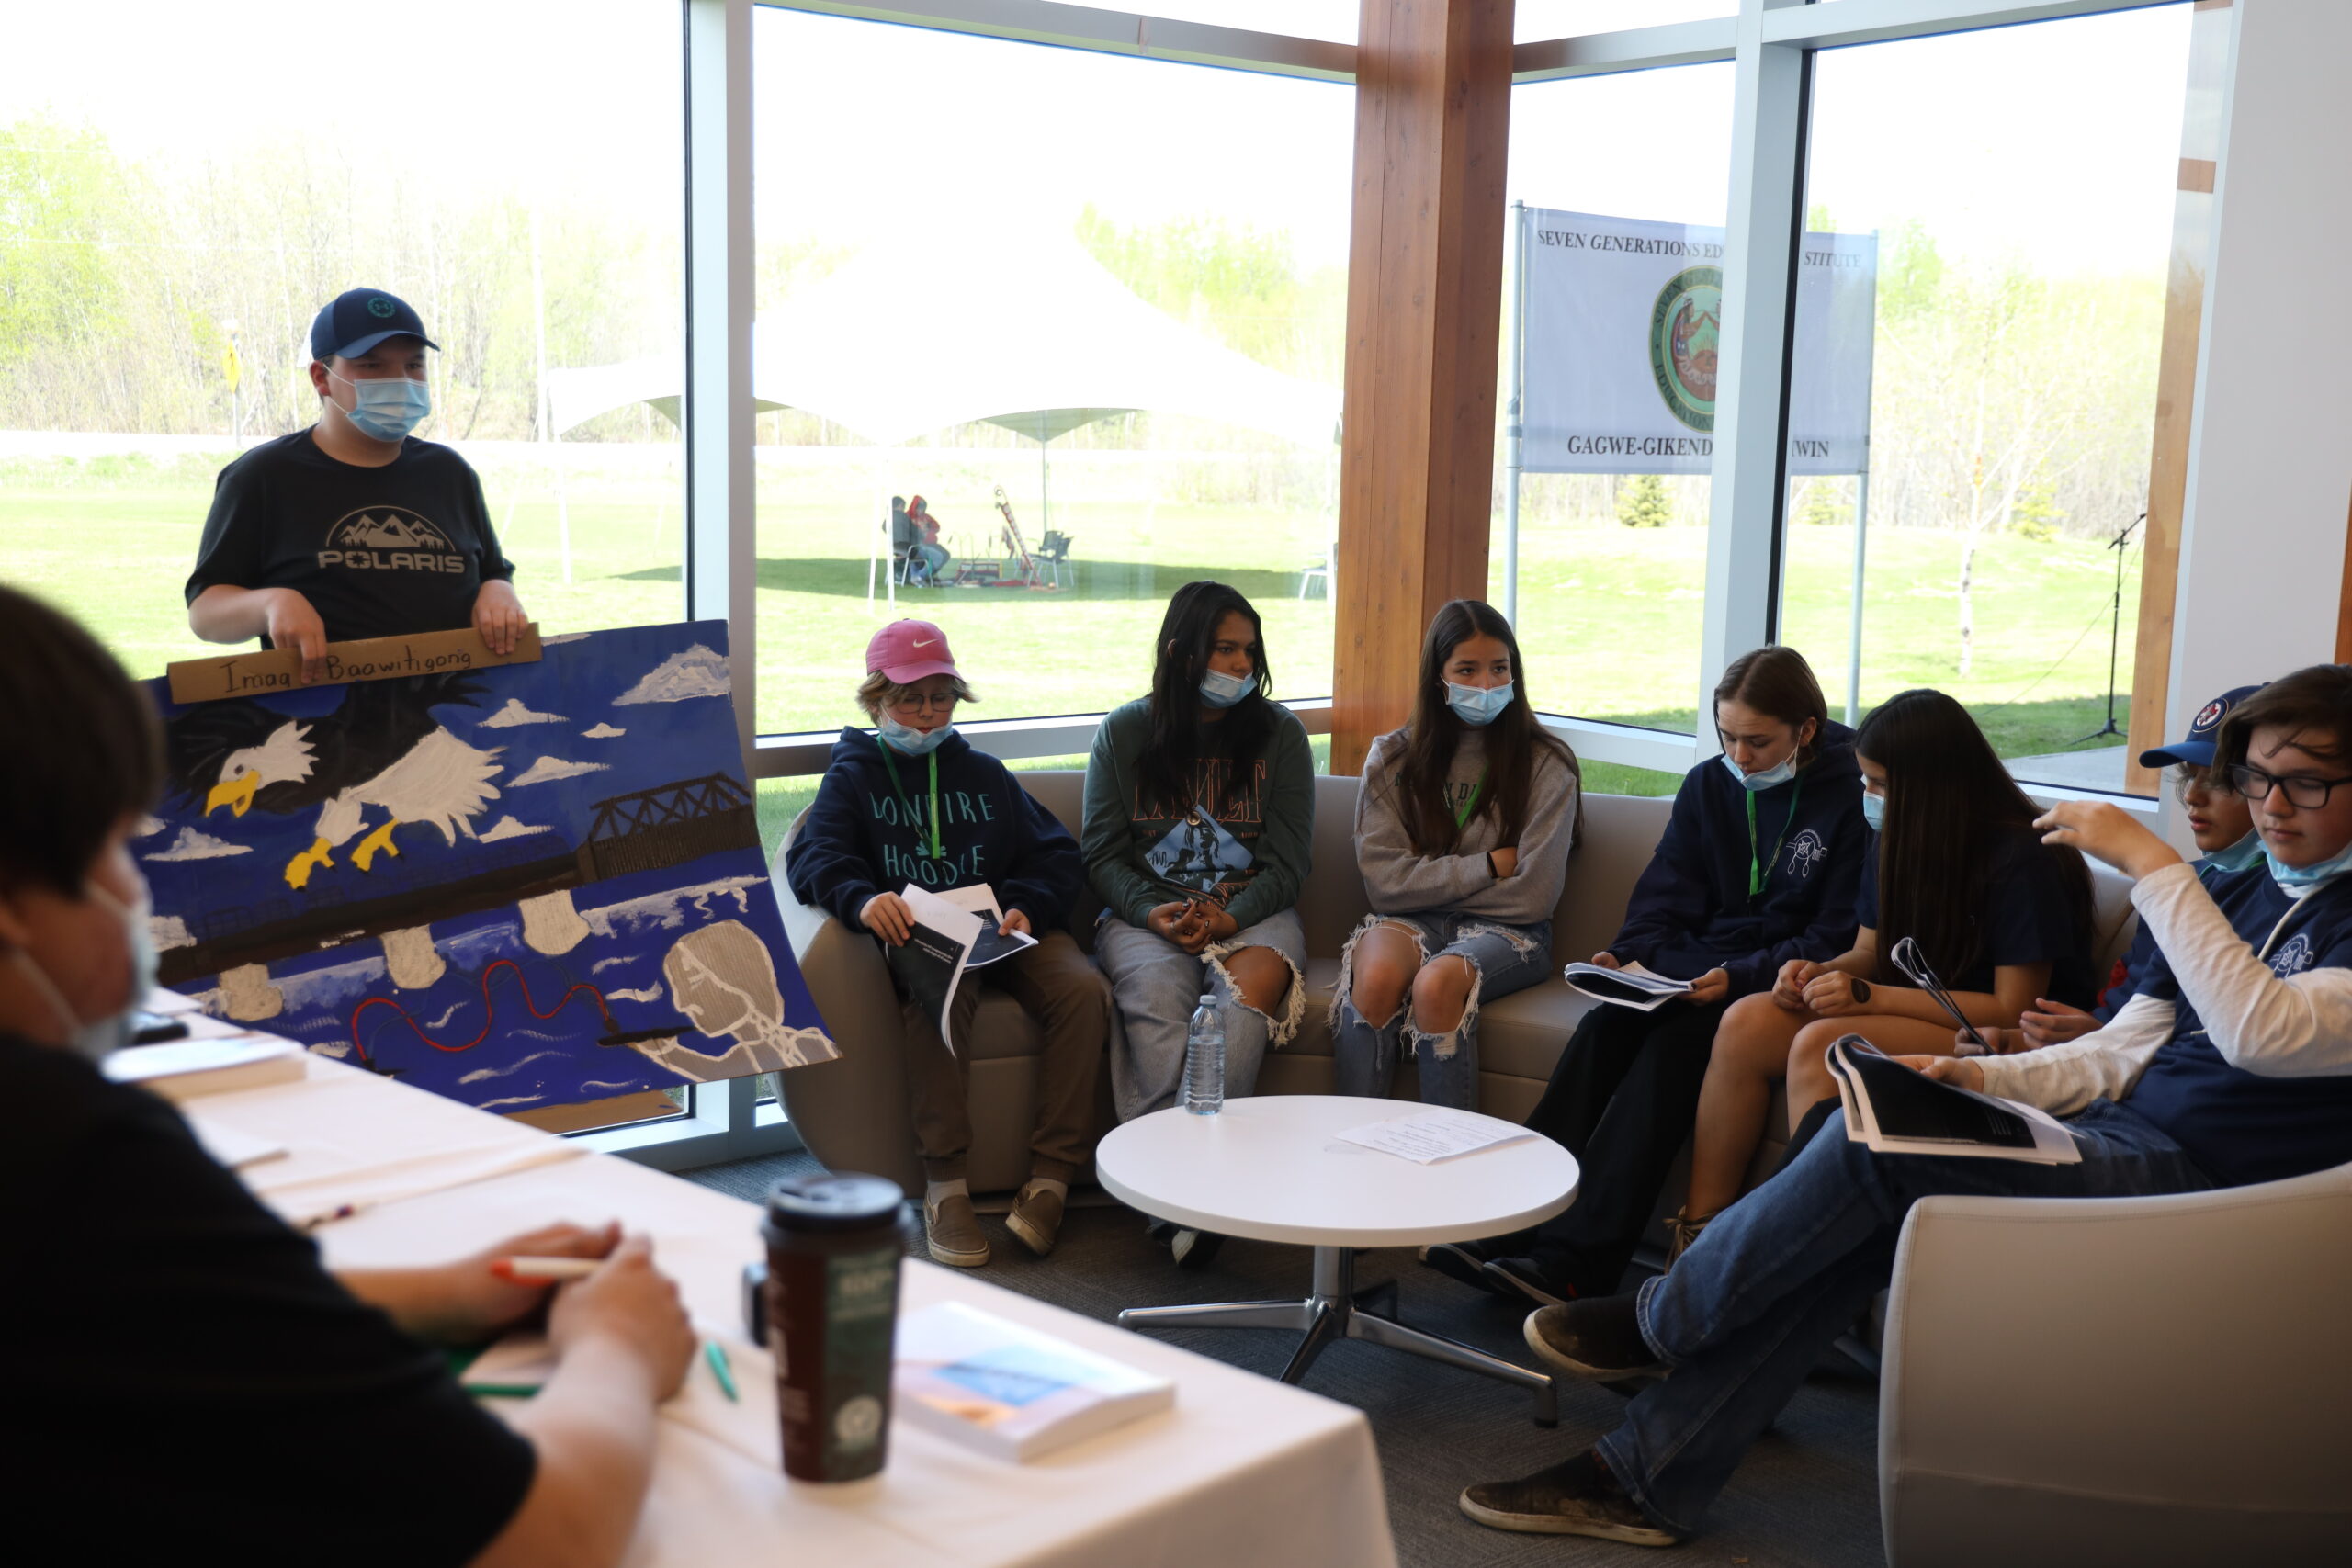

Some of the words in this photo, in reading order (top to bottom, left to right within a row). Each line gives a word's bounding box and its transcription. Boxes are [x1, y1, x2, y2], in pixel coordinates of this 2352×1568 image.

[1538, 230, 1587, 248] SEVEN
[1590, 234, 1700, 257] GENERATIONS
[318, 550, 465, 574] POLARIS
[325, 644, 471, 680] Baawitigong
[884, 844, 985, 885] HOODIE
